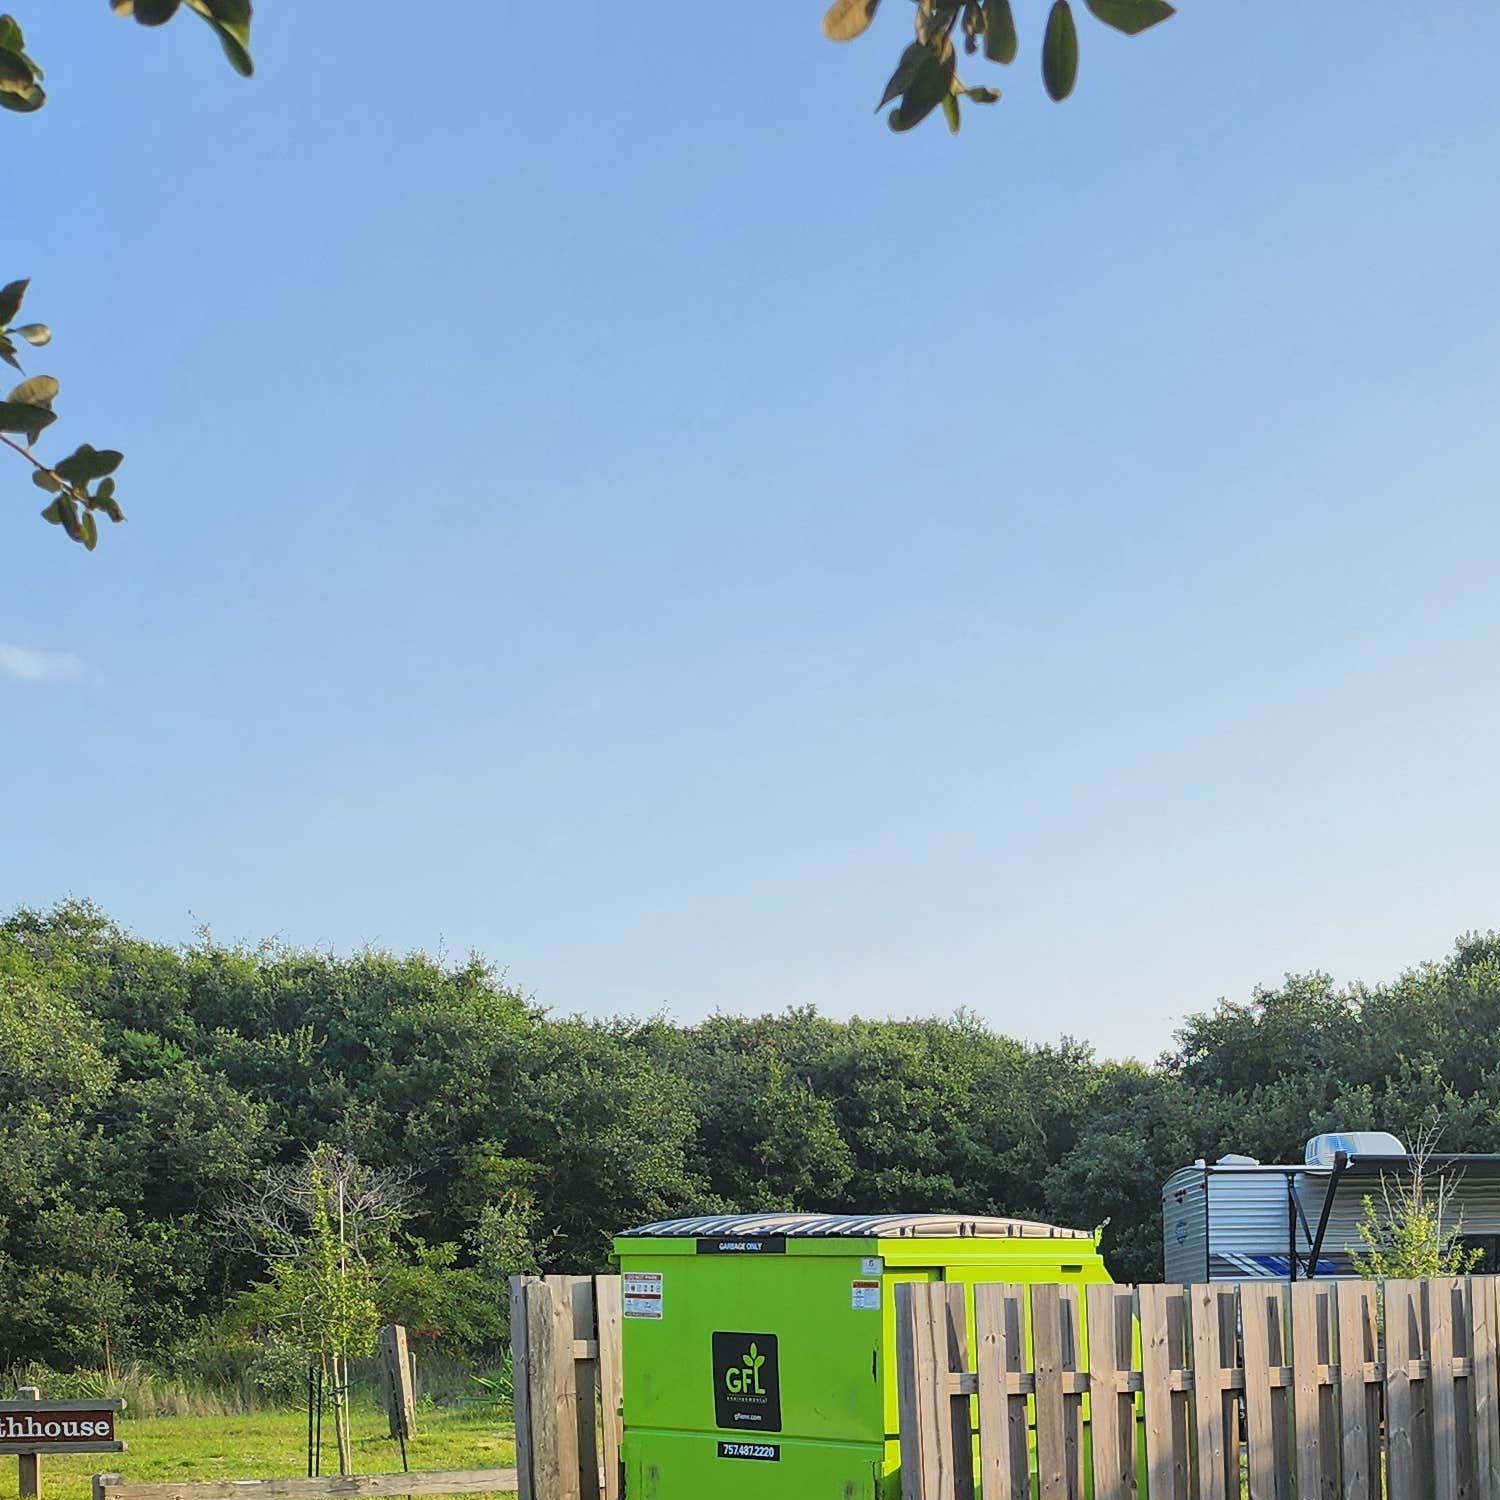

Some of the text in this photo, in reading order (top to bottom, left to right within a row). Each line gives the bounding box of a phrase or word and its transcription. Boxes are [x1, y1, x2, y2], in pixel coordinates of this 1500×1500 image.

[719, 1242, 745, 1250] GARBAGE
[726, 1366, 765, 1394] GFL
[723, 1444, 775, 1457] 757.487.2220
